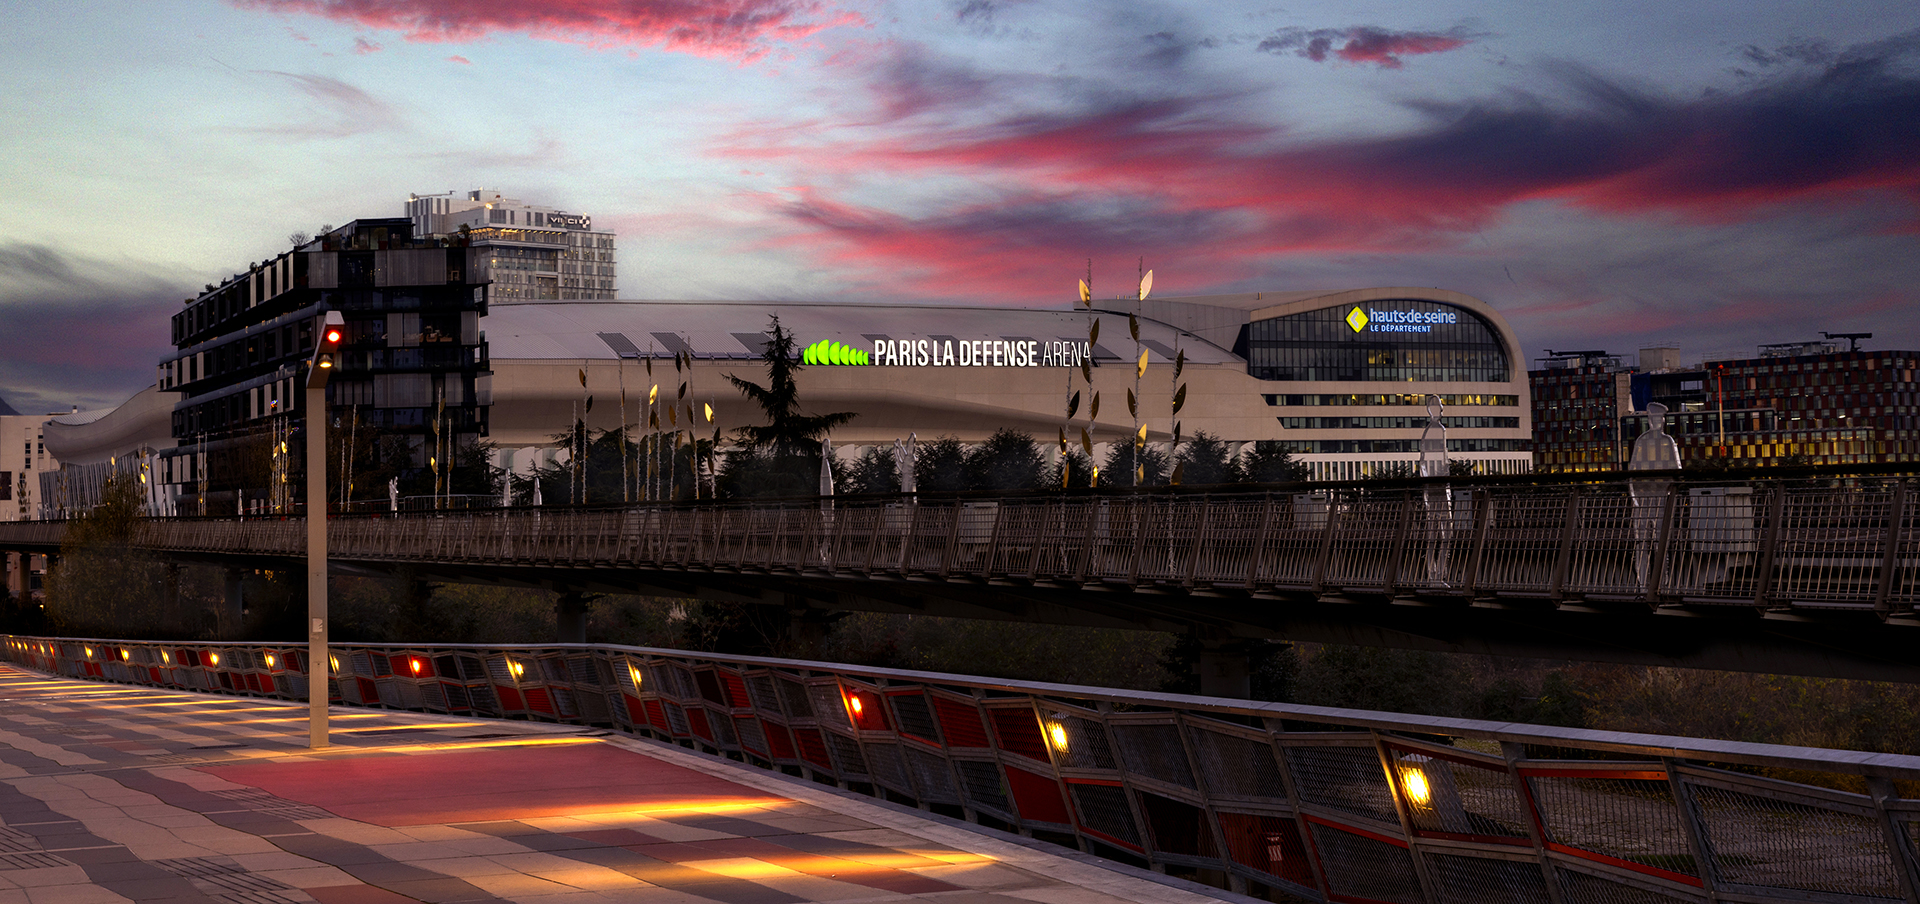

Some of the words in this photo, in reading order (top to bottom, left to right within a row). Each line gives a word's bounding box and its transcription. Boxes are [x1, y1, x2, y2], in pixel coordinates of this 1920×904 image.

[1370, 324, 1379, 332] LE
[1381, 323, 1431, 333] DÉPARTEMENT
[874, 339, 928, 366] PARIS
[932, 340, 955, 366] LA
[959, 340, 1038, 367] DEFENSE
